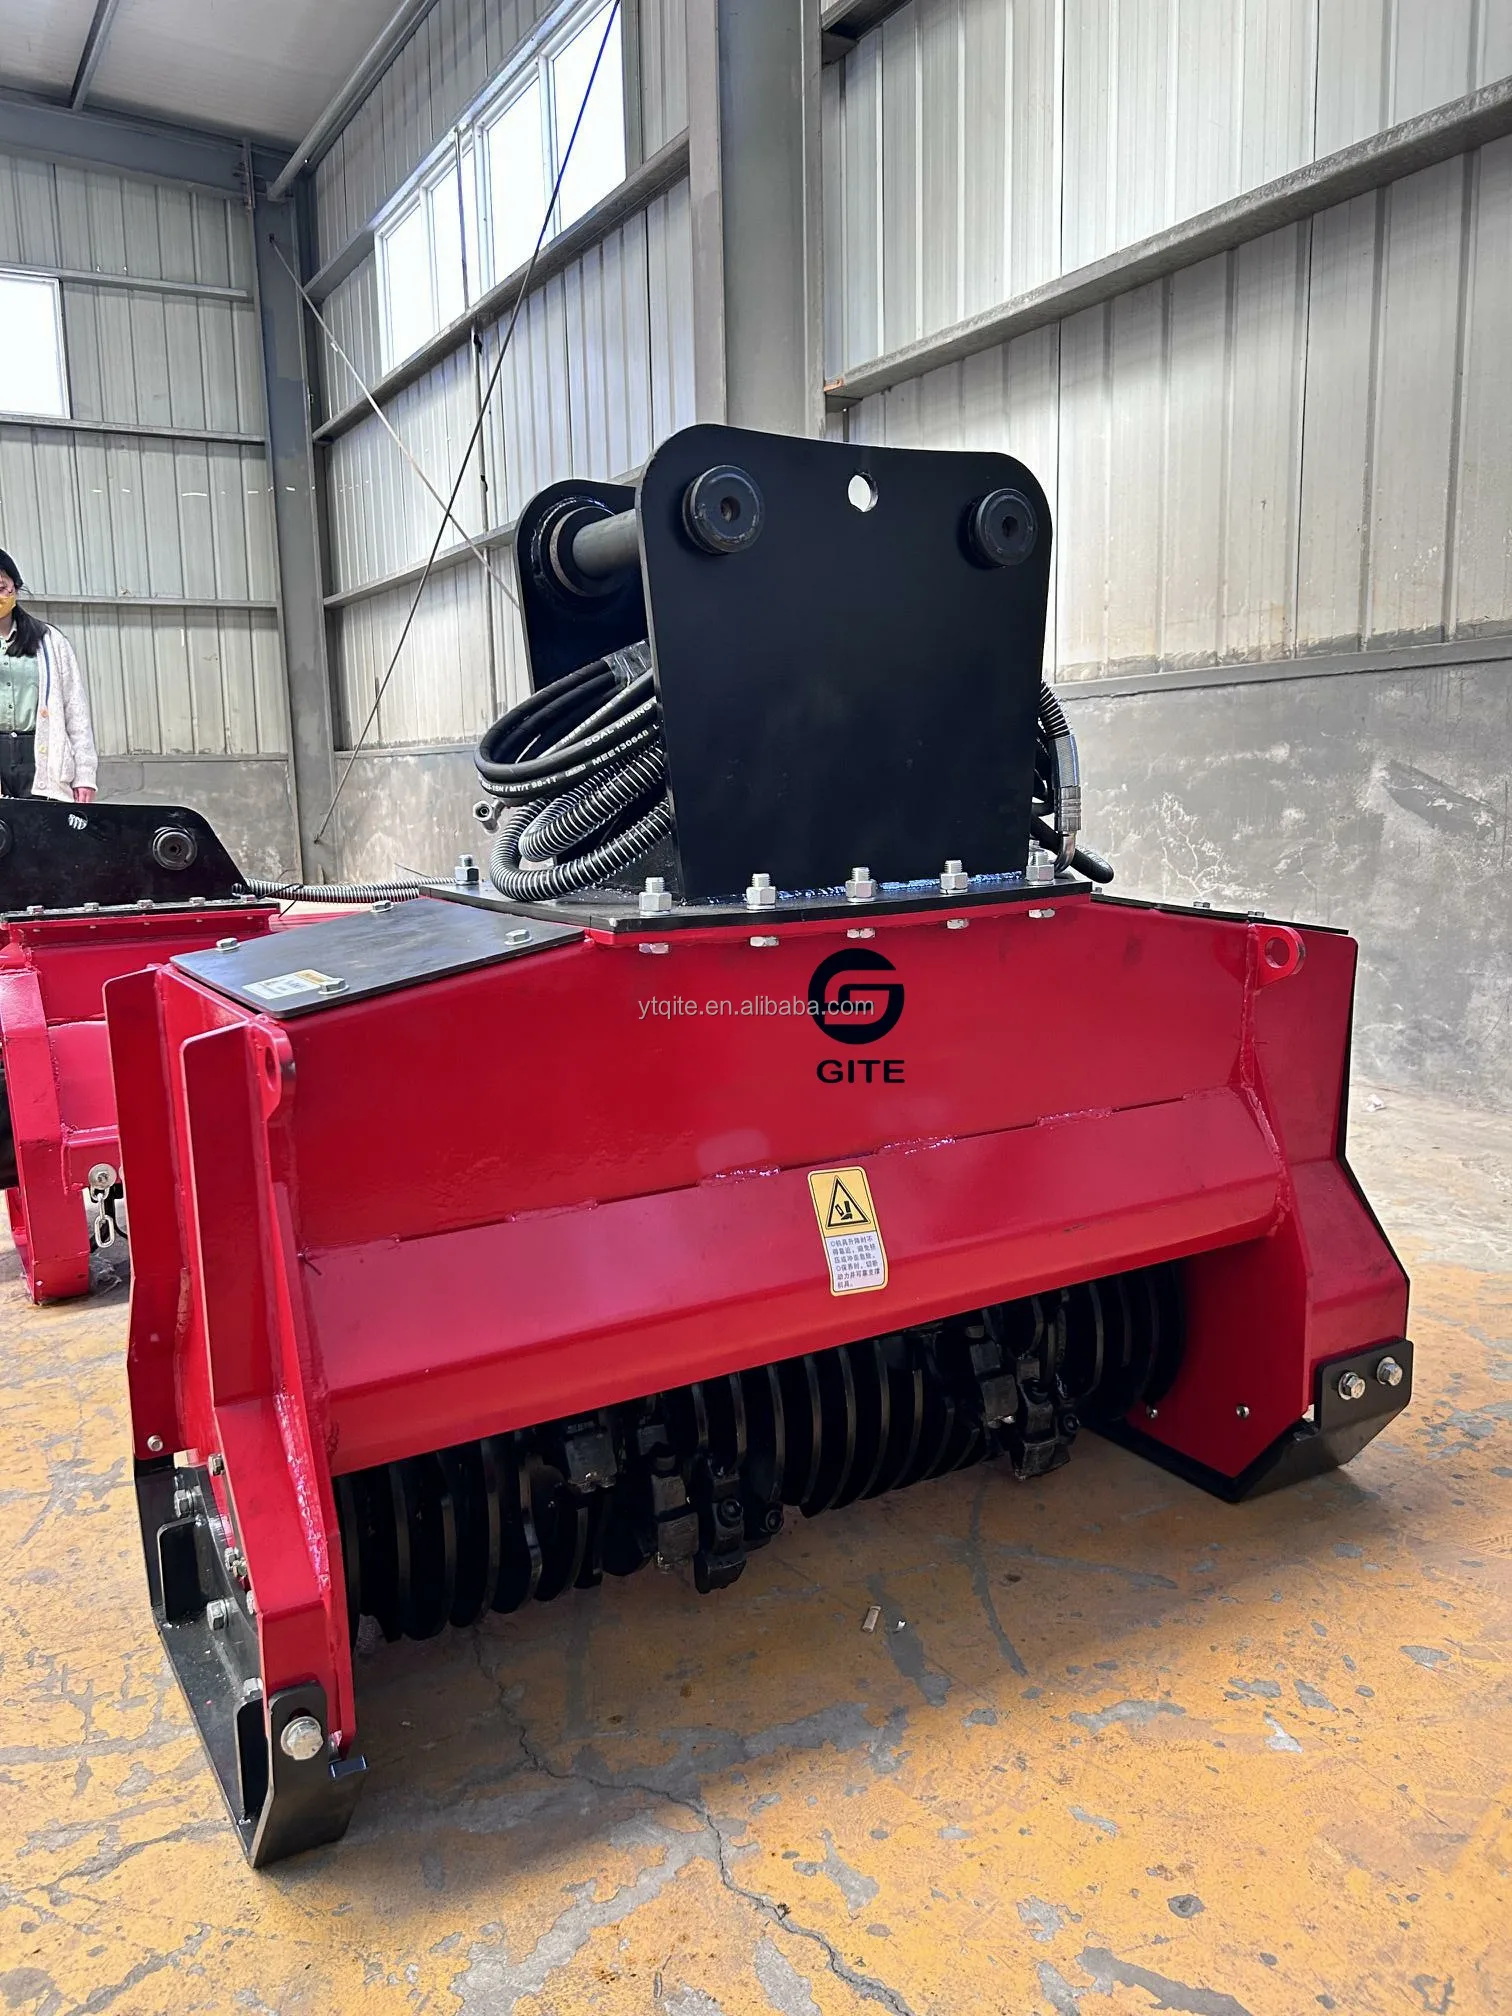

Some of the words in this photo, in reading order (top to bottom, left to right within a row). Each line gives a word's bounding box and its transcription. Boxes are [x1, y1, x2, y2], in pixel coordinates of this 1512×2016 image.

[584, 728, 615, 747] COAL
[616, 702, 652, 729] MINING
[816, 1059, 905, 1084] GITE
